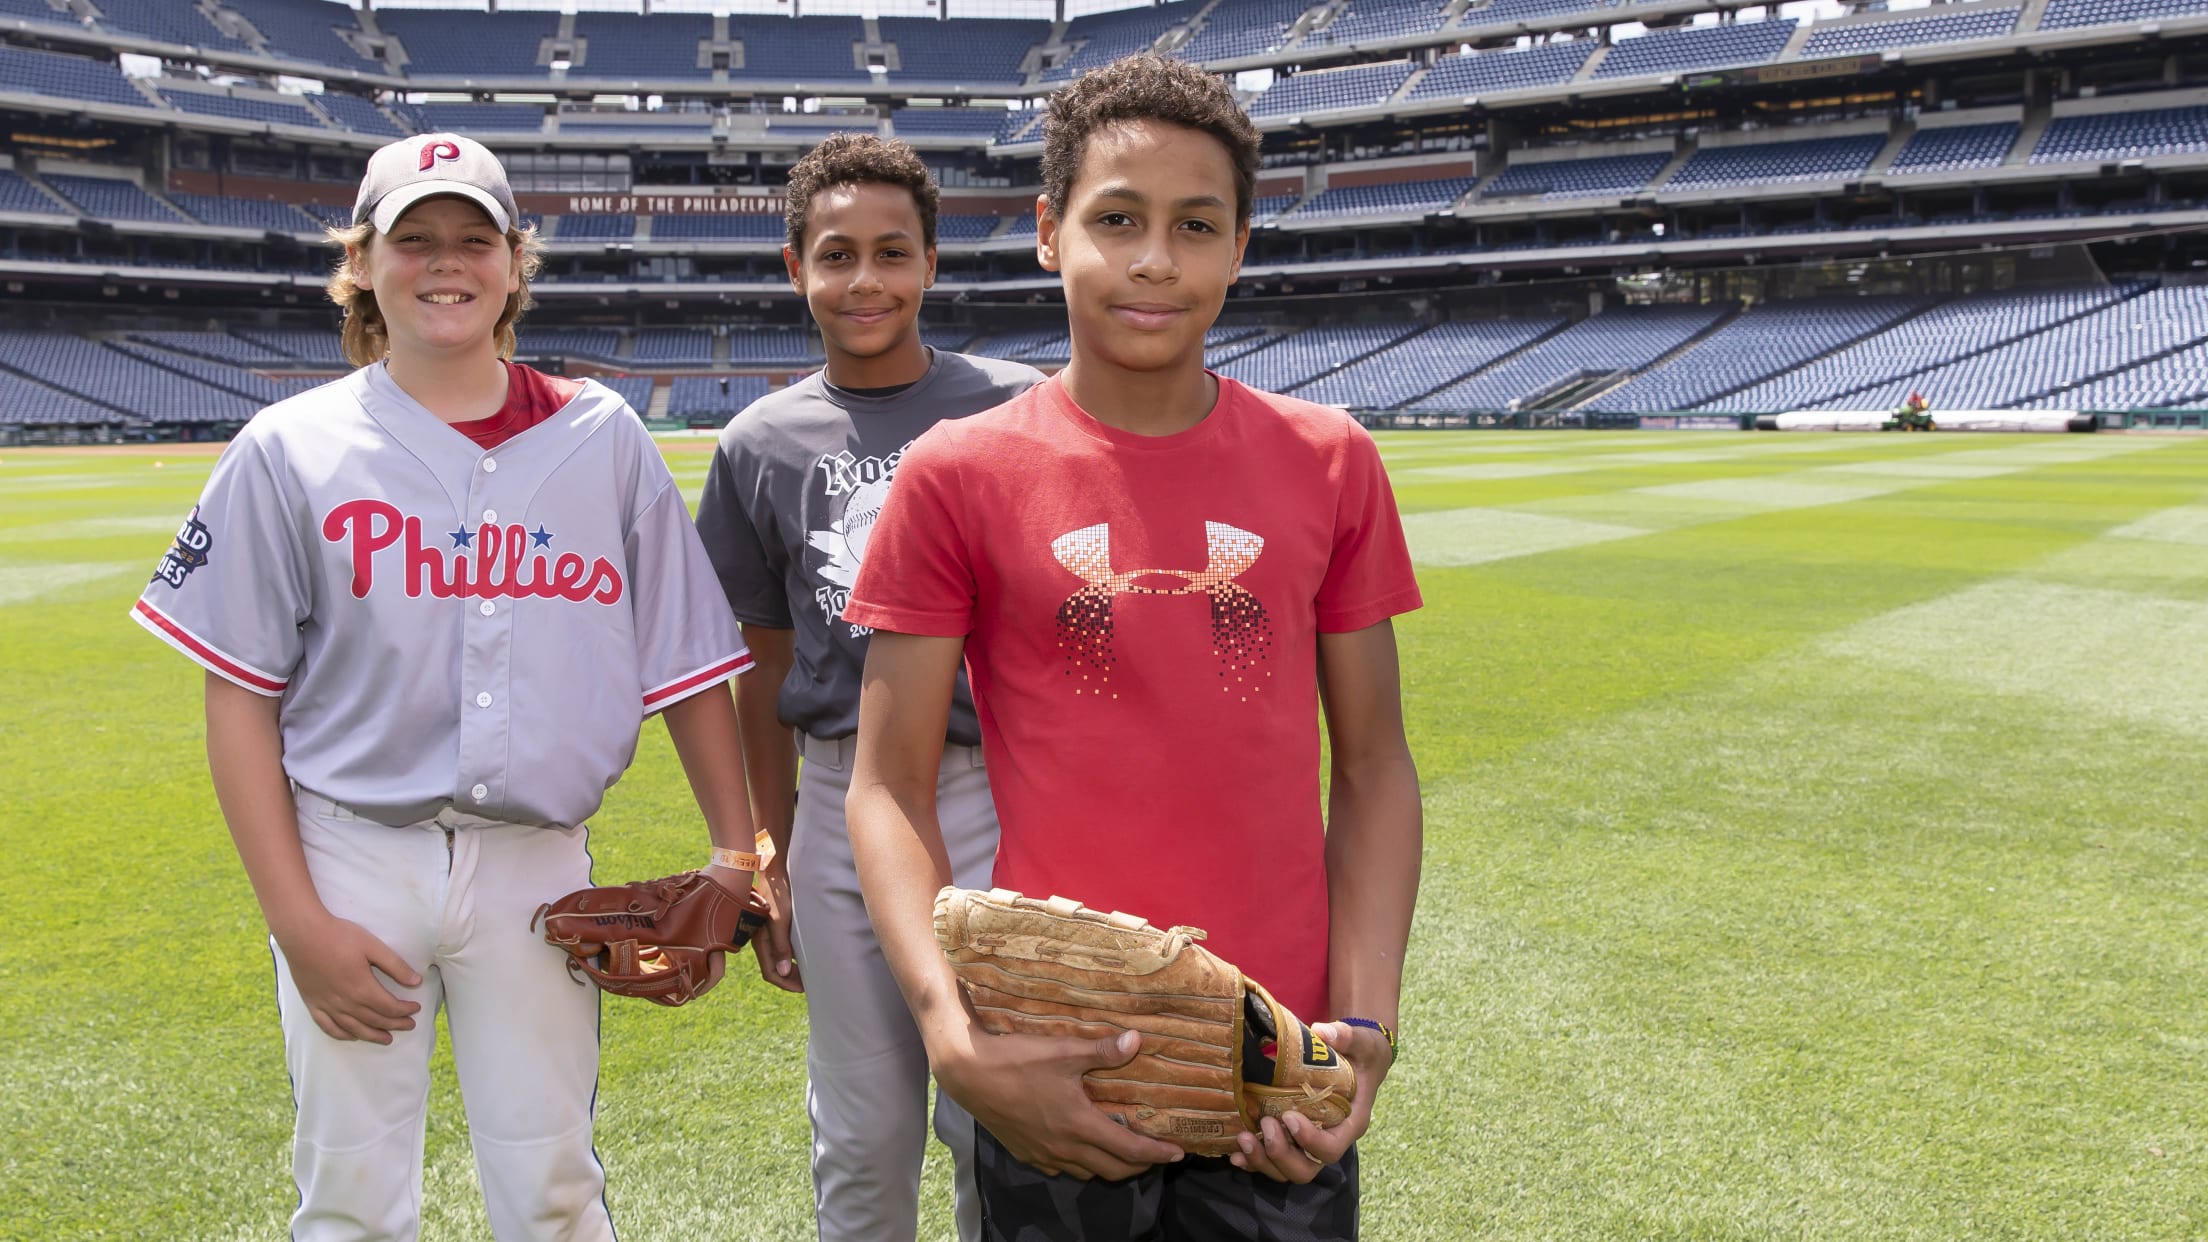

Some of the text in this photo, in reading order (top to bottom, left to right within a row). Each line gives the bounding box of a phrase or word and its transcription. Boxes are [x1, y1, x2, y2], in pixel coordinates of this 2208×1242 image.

[419, 141, 461, 172] P
[570, 197, 783, 213] HOME OF THE PHILADELPHI
[817, 440, 914, 496] Ros
[176, 521, 208, 551] RLD
[322, 498, 624, 606] Phillies
[815, 585, 854, 626] Jo
[850, 624, 874, 639] 20
[594, 914, 657, 931] Wilson
